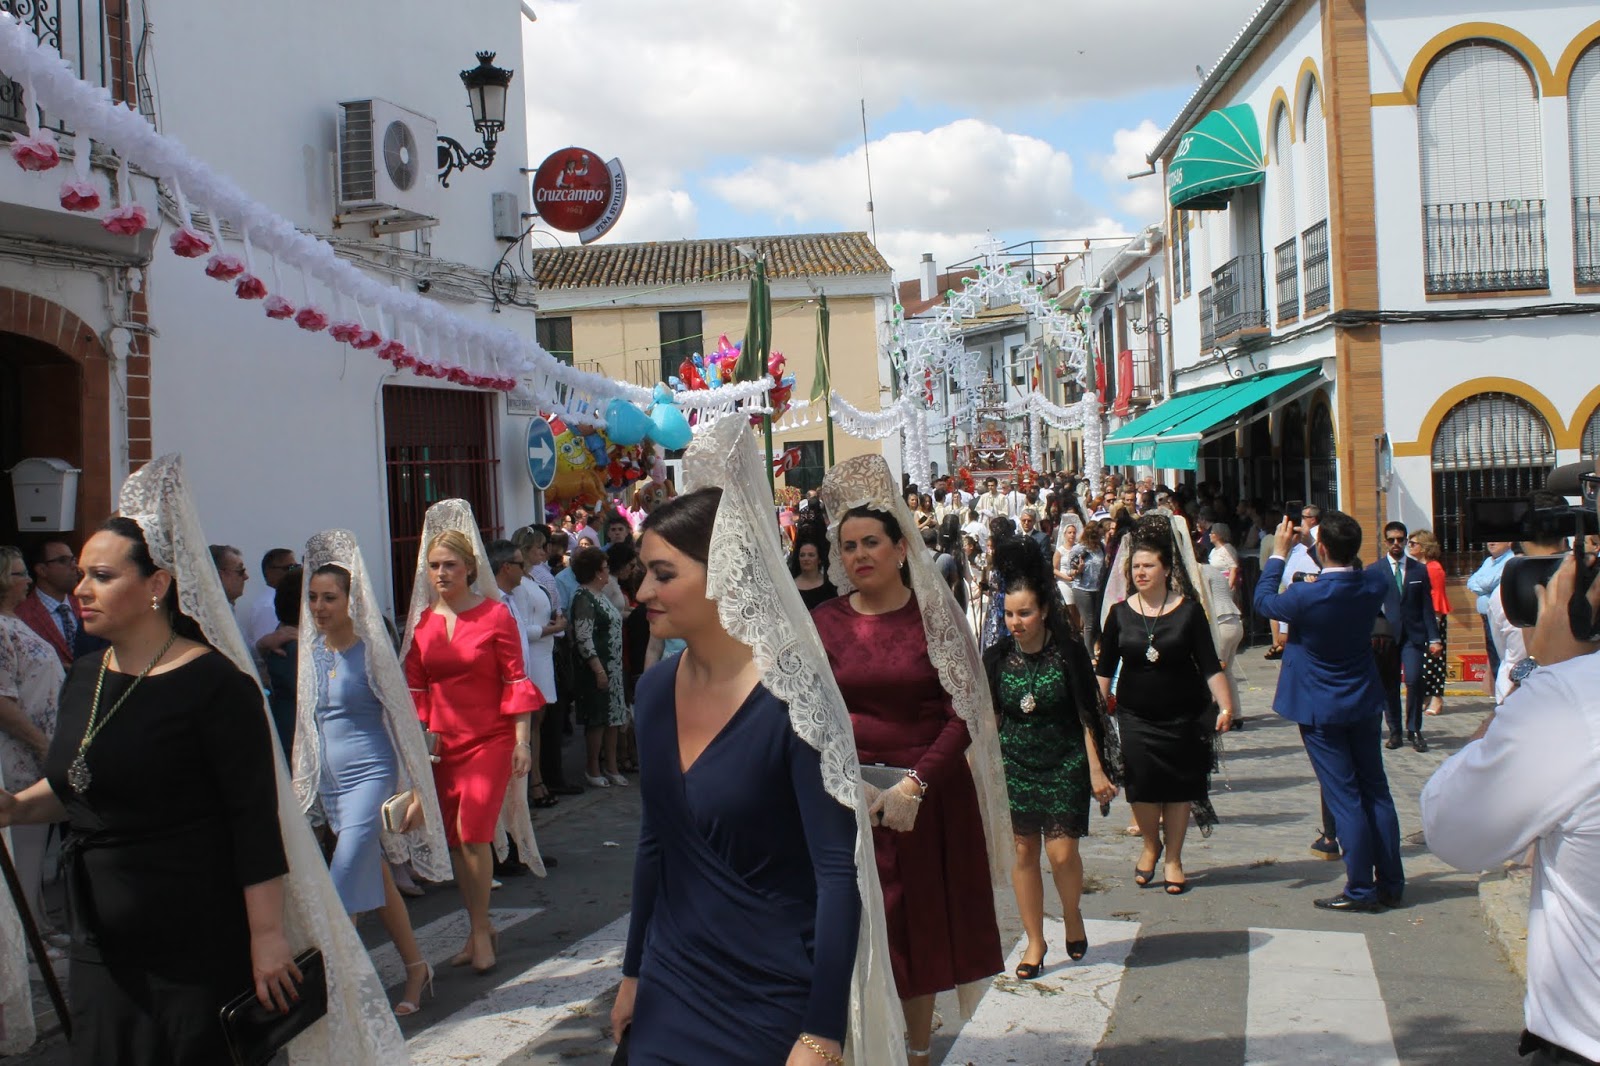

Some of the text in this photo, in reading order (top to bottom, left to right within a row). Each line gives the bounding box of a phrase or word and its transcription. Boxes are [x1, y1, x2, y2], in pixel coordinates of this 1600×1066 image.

[537, 187, 604, 204] Cruzcampo
[595, 173, 622, 233] PEÑA SEVILLISTA
